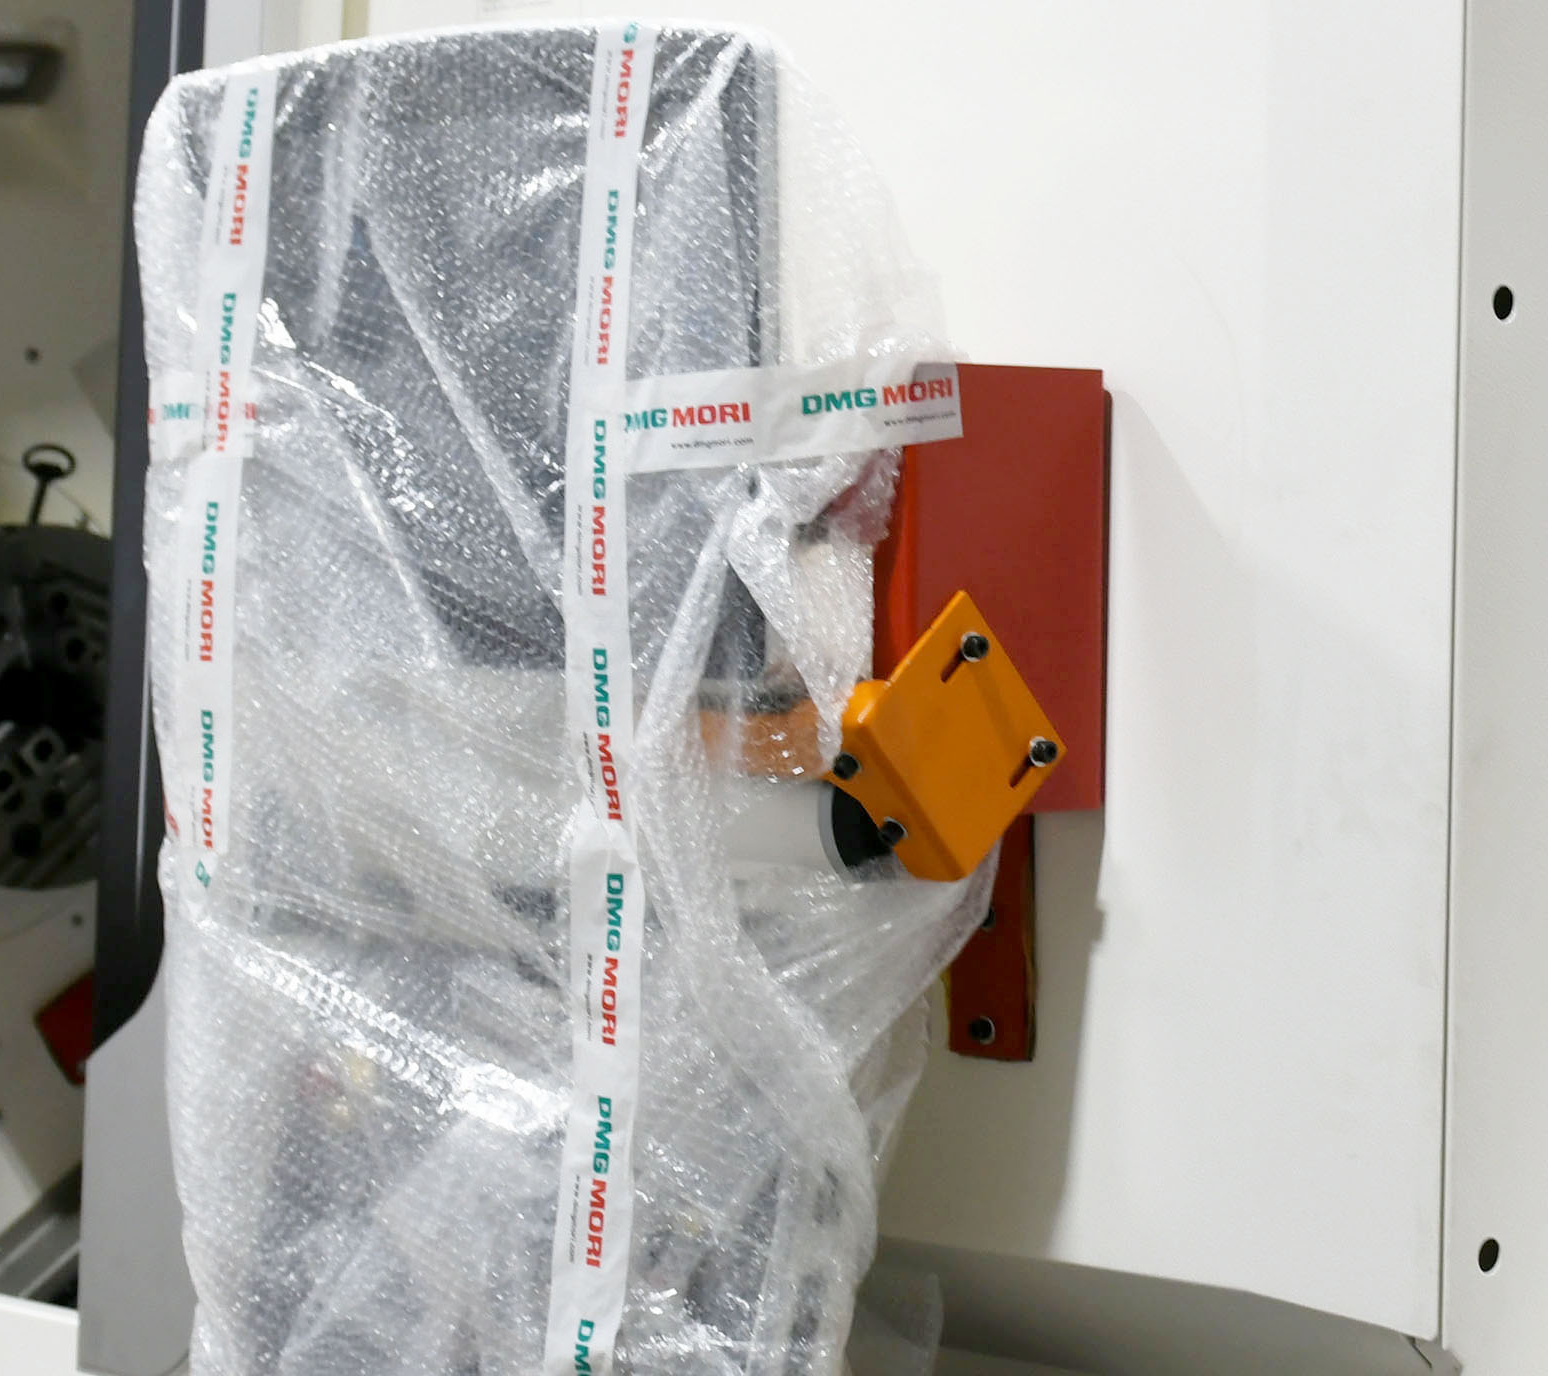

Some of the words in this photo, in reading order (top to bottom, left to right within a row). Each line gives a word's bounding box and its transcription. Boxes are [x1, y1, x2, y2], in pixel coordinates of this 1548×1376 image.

[239, 88, 257, 158] DMG
[615, 50, 634, 137] MORI
[229, 165, 248, 245] MORI
[604, 190, 618, 269] DMG
[220, 293, 236, 364] DMG
[597, 277, 612, 364] MORI
[673, 403, 751, 426] MORI
[803, 388, 876, 415] DMG
[883, 376, 953, 405] MORI
[593, 420, 606, 499] DMG
[202, 502, 218, 574] DMG
[592, 507, 606, 595] MORI
[200, 580, 214, 661] MORI
[593, 648, 610, 727] DMG
[202, 711, 213, 781] DMG
[598, 734, 622, 820] MORI
[607, 874, 623, 950] DMG
[602, 957, 618, 1045] MORI
[593, 1097, 612, 1174] DMG
[587, 1179, 606, 1267] MORI
